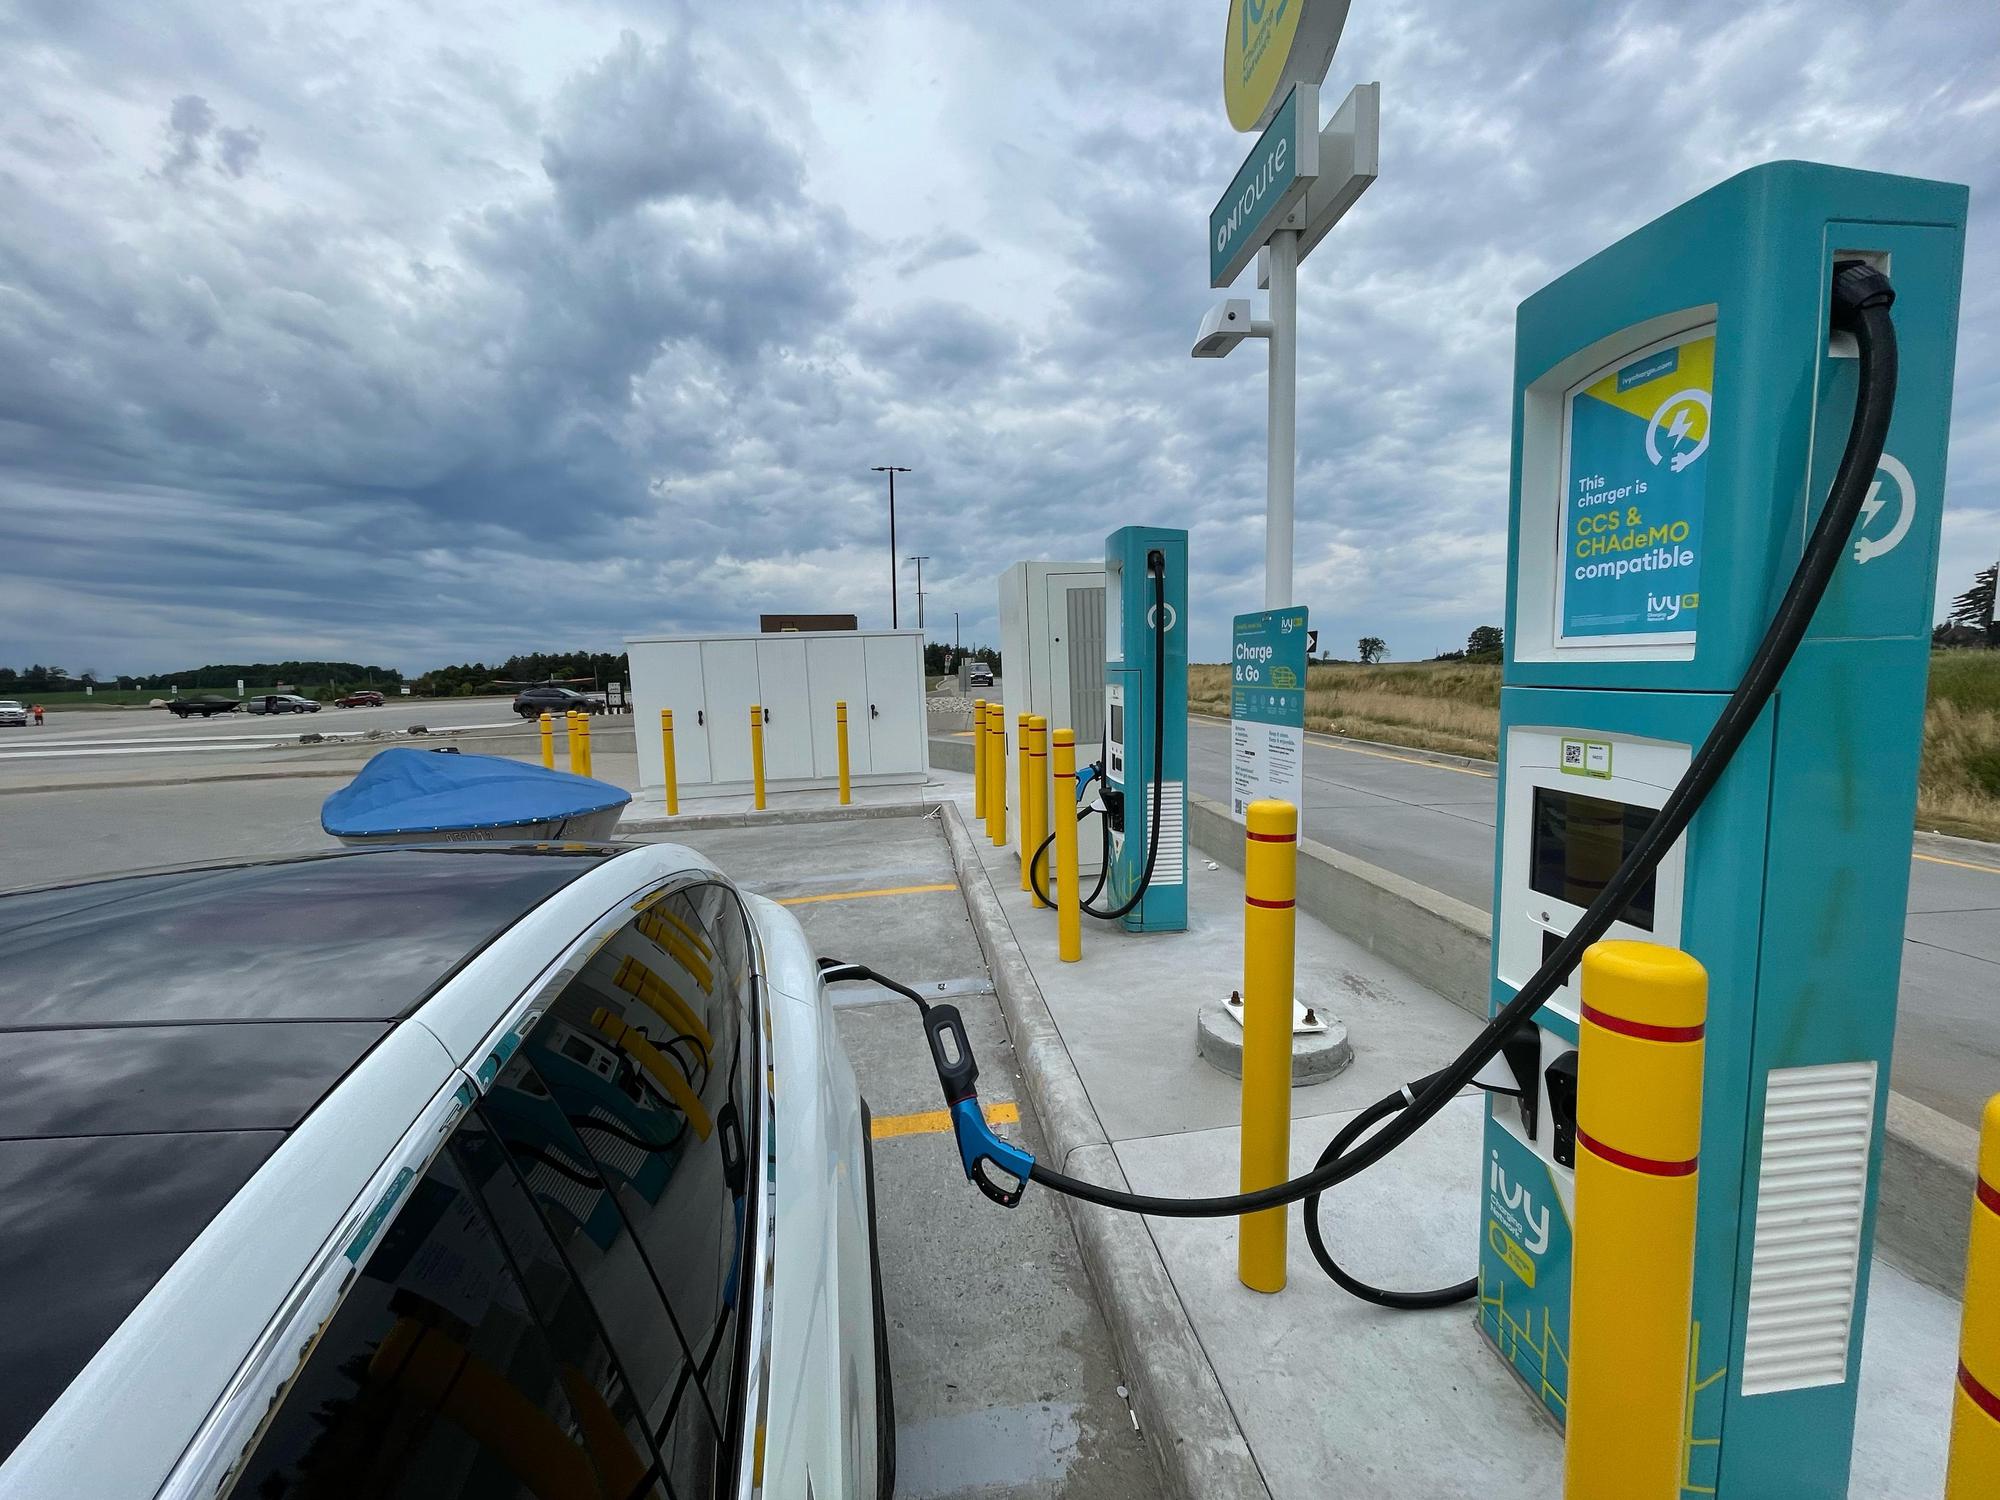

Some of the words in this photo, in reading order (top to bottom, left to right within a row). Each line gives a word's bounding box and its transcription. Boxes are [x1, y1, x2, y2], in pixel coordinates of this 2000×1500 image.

[1577, 485, 1632, 508] charger
[1635, 479, 1648, 494] is
[1578, 474, 1605, 493] This
[1577, 510, 1620, 536] CCS
[1626, 506, 1642, 527] &
[1576, 520, 1690, 558] CHAdeMO
[1574, 545, 1694, 580] compatible
[1647, 592, 1680, 621] ivy
[1281, 616, 1293, 633] ivy
[1235, 642, 1273, 663] Charge
[1235, 664, 1243, 681] &
[1245, 664, 1260, 682] Go
[1490, 1149, 1550, 1255] ivy
[1490, 1193, 1523, 1234] Charging
[1489, 1202, 1521, 1240] Network
